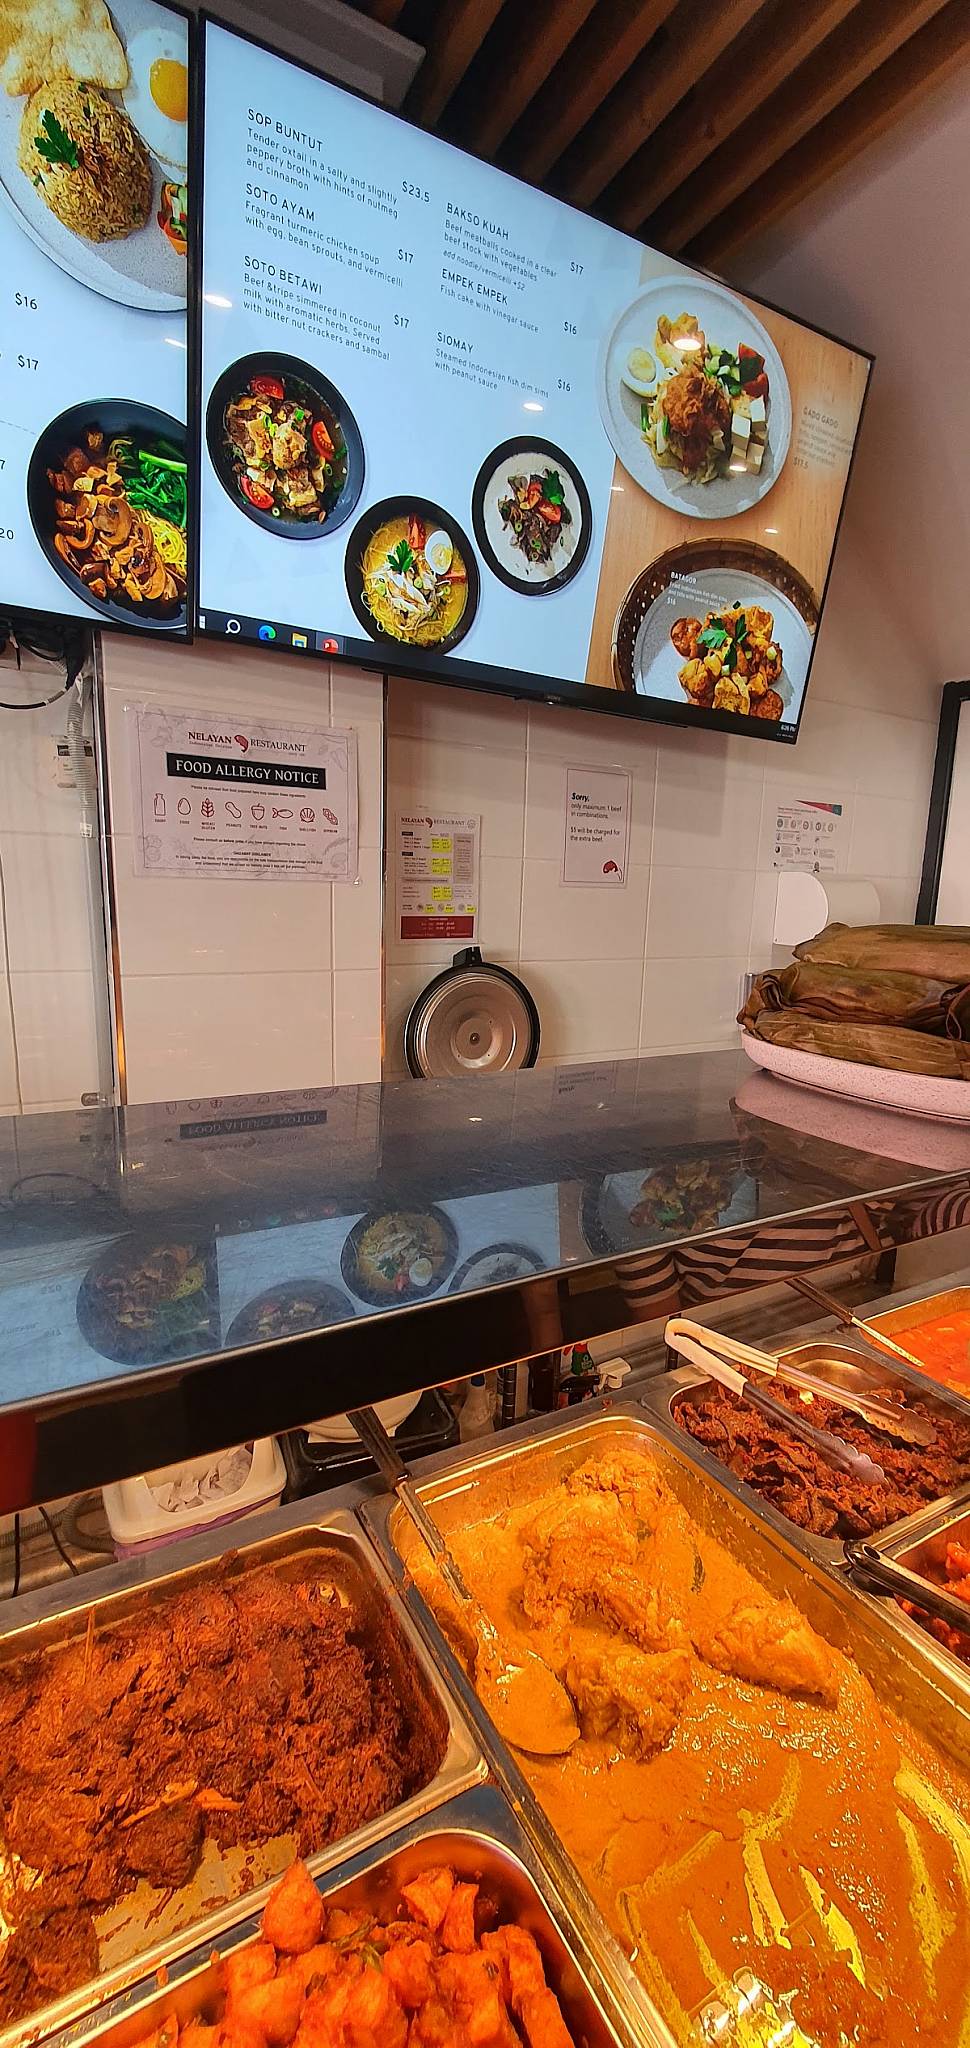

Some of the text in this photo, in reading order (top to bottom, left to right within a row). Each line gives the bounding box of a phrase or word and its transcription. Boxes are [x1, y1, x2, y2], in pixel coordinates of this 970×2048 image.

[248, 109, 324, 152] SOP BUNTUT
[247, 158, 309, 191] and cinnamon
[247, 144, 398, 220] peppery broth with hints of nutmeg
[248, 128, 398, 205] Tender oxtail in a salty and slightly
[246, 184, 315, 222] SOTO AYAM
[402, 181, 430, 203] $23.5
[246, 201, 380, 265] Fragrant turmeric chicken soup
[447, 203, 510, 241] BAKSO KUAH
[245, 216, 403, 288] with egg, bean sprouts, and vermicelli
[398, 249, 414, 264] $17
[443, 250, 456, 260] add
[444, 233, 538, 282] beef stock with vegetables
[446, 220, 463, 234] Beef
[465, 230, 499, 251] meatballs
[501, 248, 526, 264] cooked
[527, 258, 533, 268] in
[541, 265, 557, 278] clear
[245, 256, 322, 295] SOTO BETAWI
[442, 269, 508, 306] EMPEK EMPEK
[570, 262, 584, 276] $17
[16, 293, 38, 310] $16
[244, 288, 380, 345] milk with aromatic herbs. Served
[245, 274, 265, 288] Beef
[297, 295, 338, 317] simmered
[340, 309, 347, 320] in
[350, 315, 382, 333] coconut
[441, 285, 539, 333] Fish cake with vinegar sauce
[244, 301, 390, 361] with bitter nut crackers and sambal
[394, 314, 410, 329] $17
[564, 321, 577, 335] $16
[437, 332, 474, 353] SIOMAY
[18, 355, 39, 371] $17
[435, 361, 498, 390] with peanut sauce
[436, 348, 549, 398] Steamed Indonesian fish dim sims
[558, 379, 571, 392] $16
[188, 731, 306, 752] NELAYAN RESTAURANT
[176, 760, 319, 784] FOOD ALLERGY NOTICE
[571, 792, 590, 802] Sorry,
